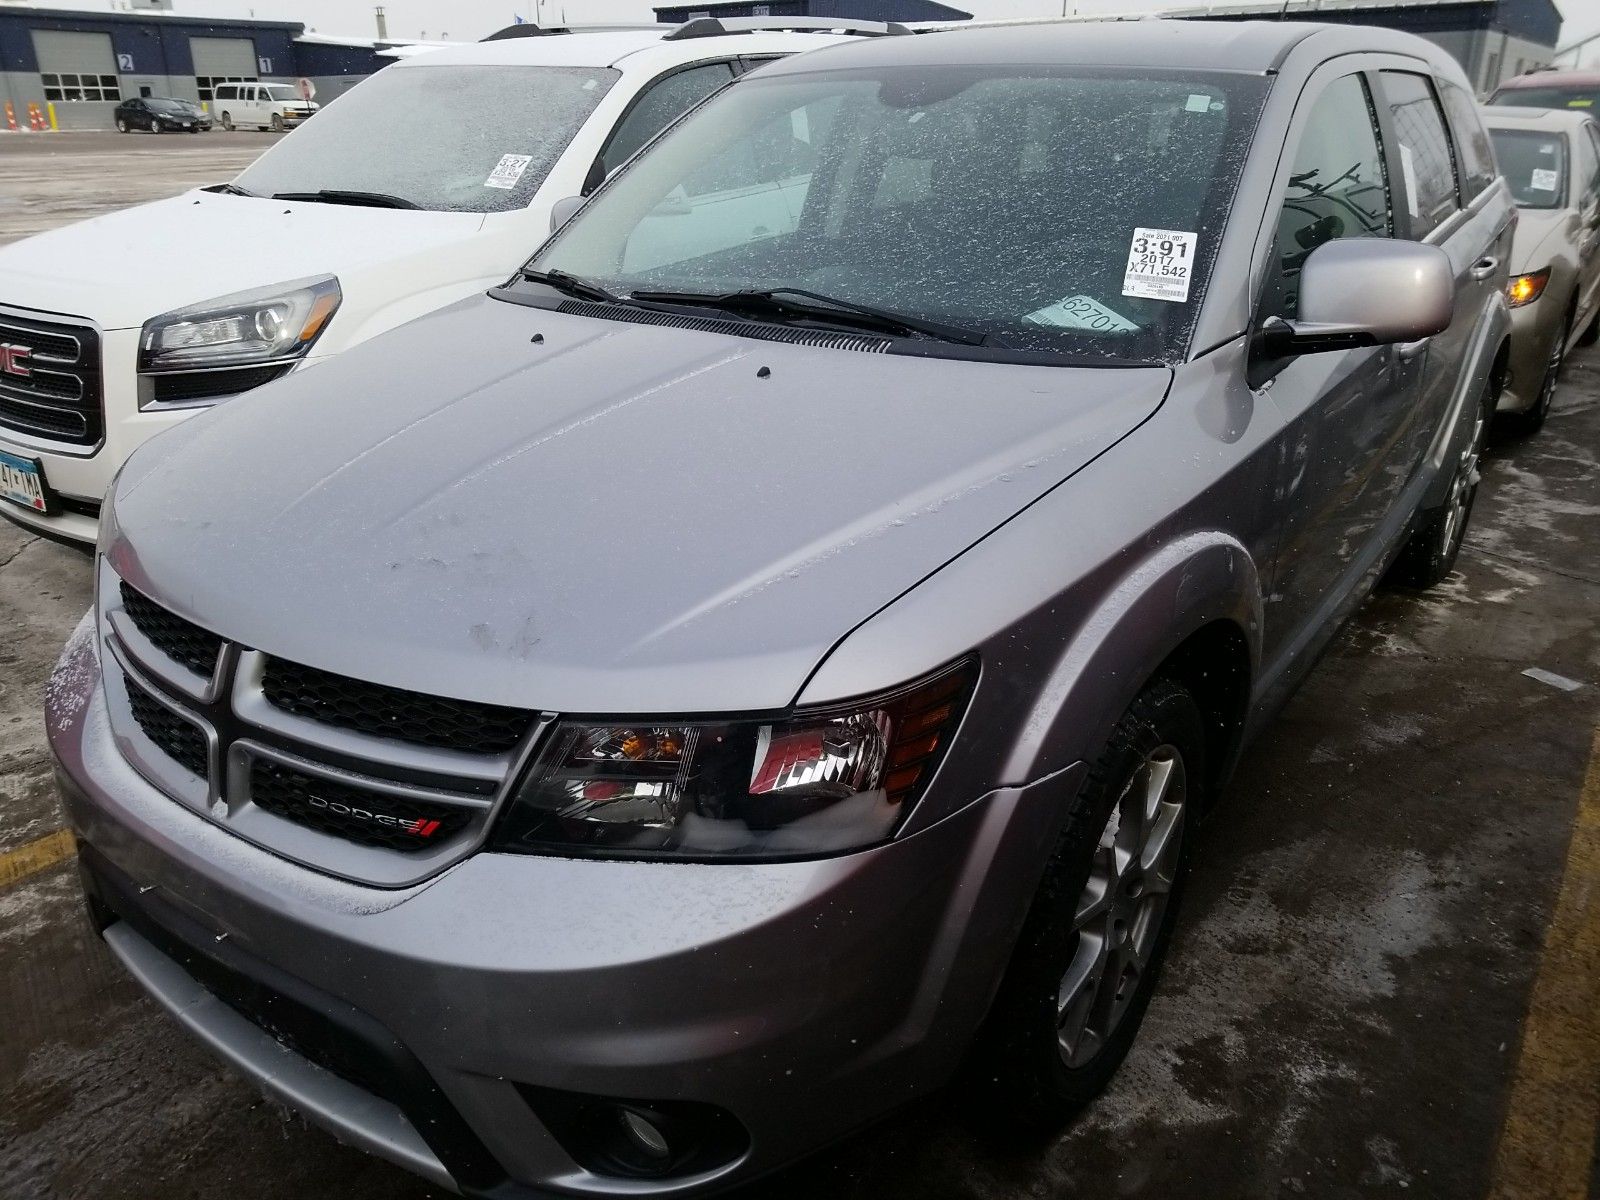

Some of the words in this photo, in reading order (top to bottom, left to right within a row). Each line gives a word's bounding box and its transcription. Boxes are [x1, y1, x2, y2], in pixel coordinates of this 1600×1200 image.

[753, 7, 768, 16] EXIT
[120, 55, 132, 70] 2
[1134, 238, 1187, 258] 3:91
[1140, 254, 1174, 266] 2017
[1129, 262, 1187, 278] X71,542
[308, 795, 420, 832] DODGE
